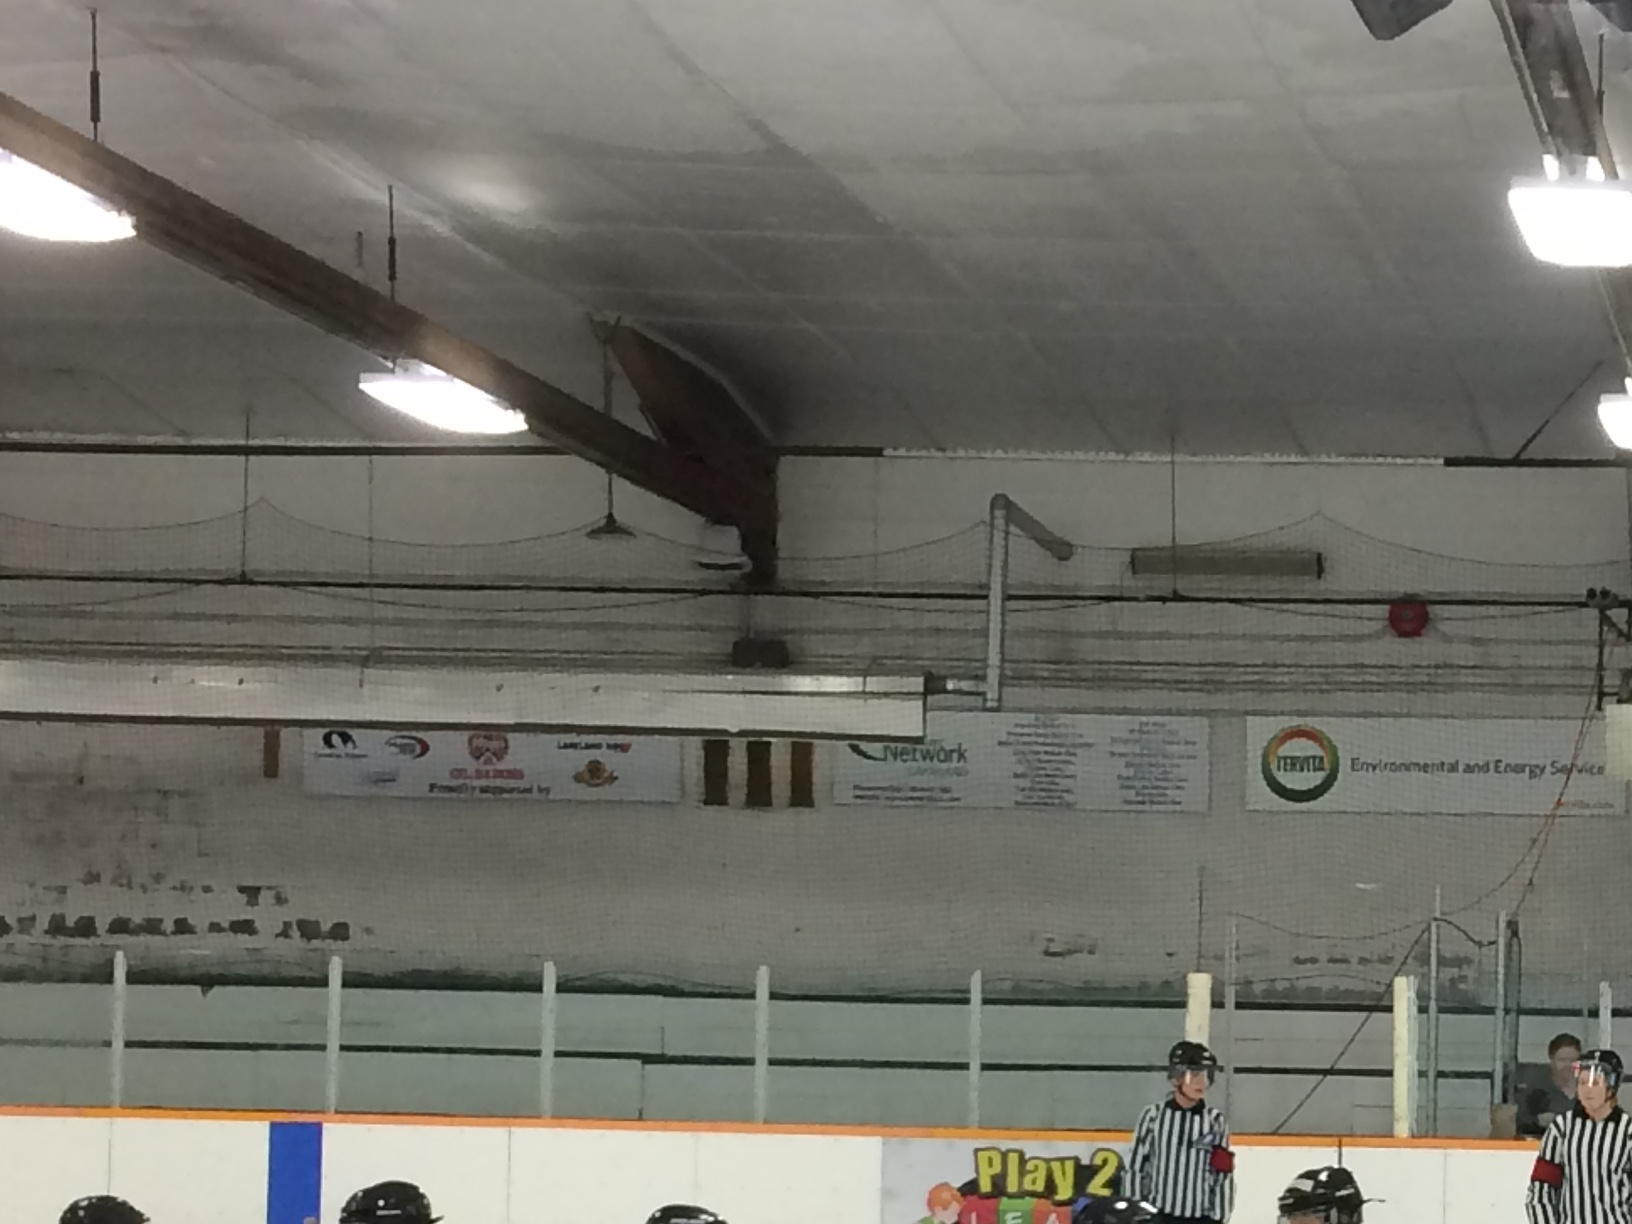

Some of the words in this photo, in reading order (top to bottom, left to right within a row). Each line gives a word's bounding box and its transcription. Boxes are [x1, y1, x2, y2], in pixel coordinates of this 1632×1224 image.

[882, 742, 968, 764] Network
[1276, 755, 1325, 773] TERVITA
[1350, 757, 1460, 775] Environmental
[1463, 759, 1491, 775] and
[1494, 759, 1546, 781] Energy
[1550, 760, 1605, 777] Service
[974, 1147, 1081, 1204] Play
[1087, 1147, 1124, 1198] 2
